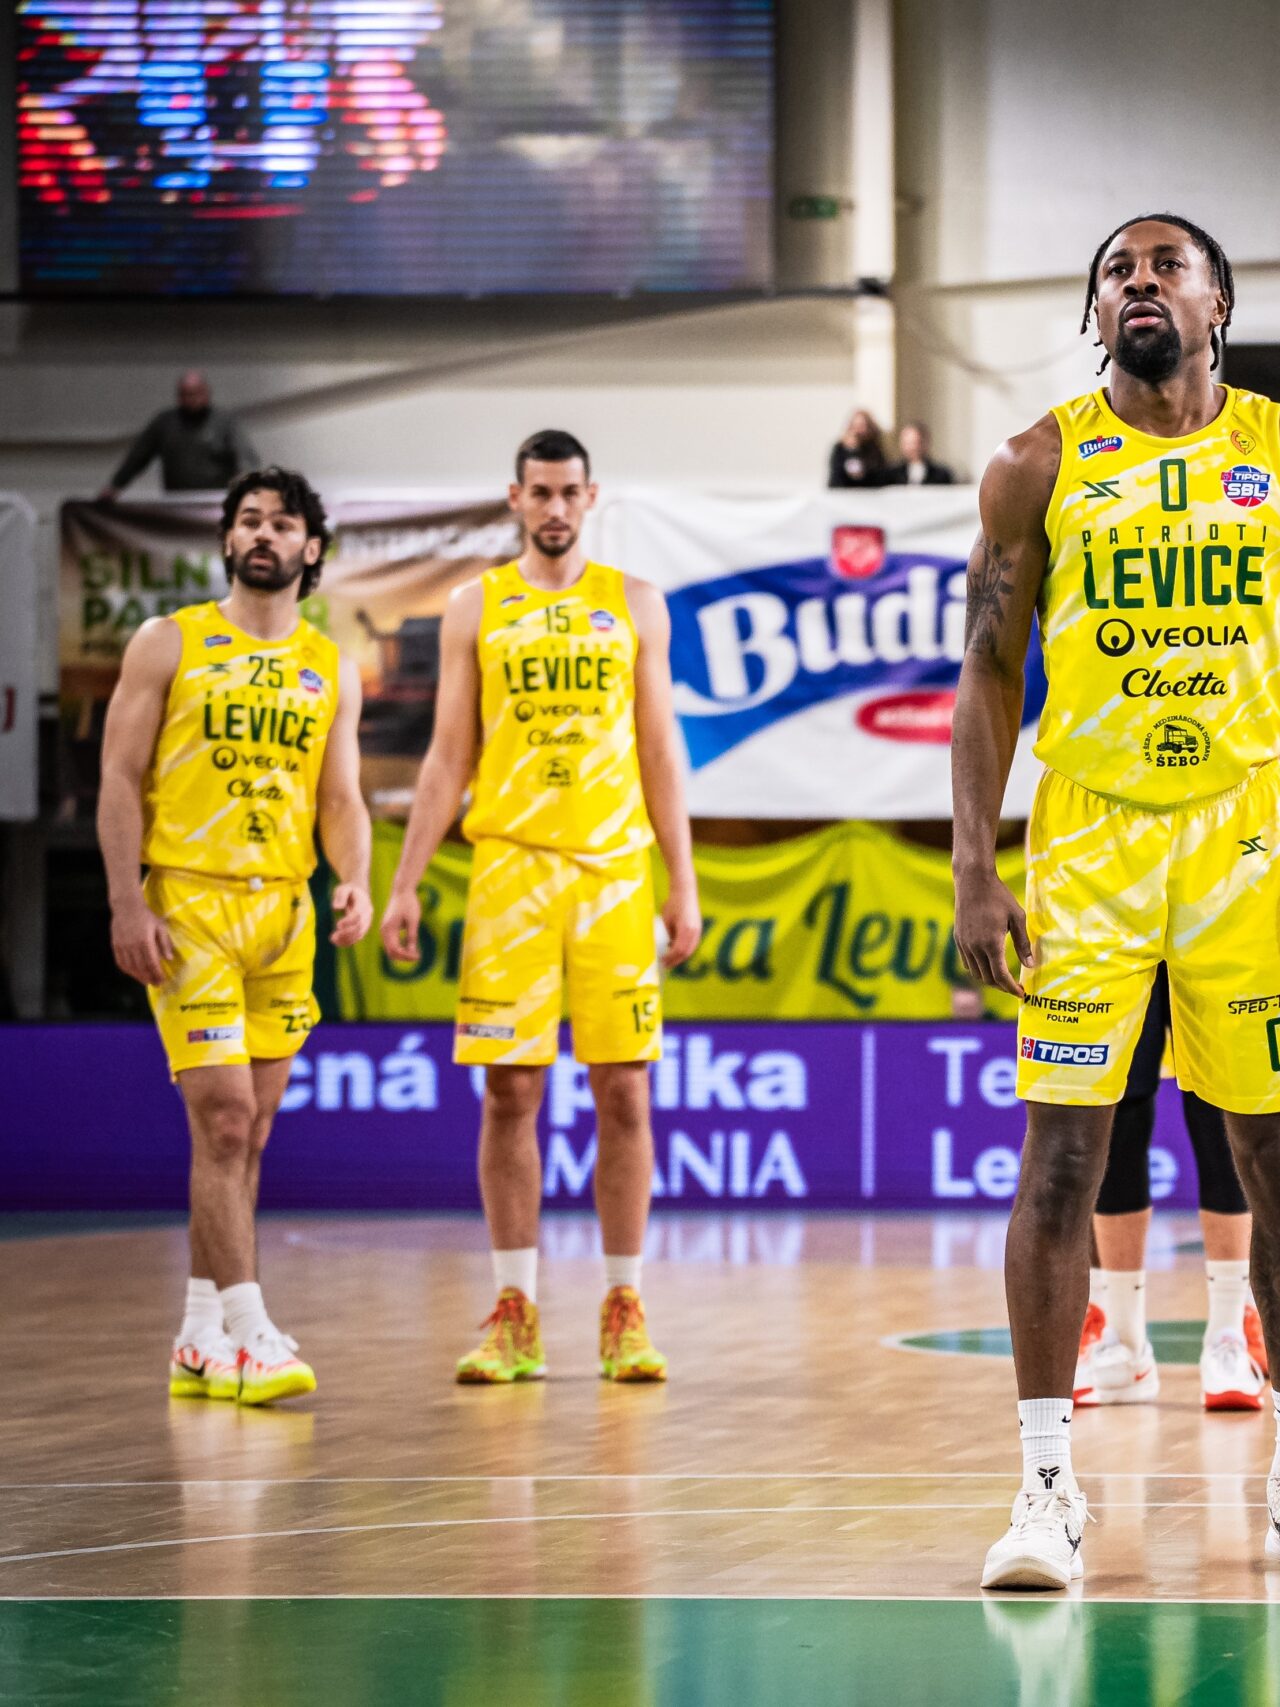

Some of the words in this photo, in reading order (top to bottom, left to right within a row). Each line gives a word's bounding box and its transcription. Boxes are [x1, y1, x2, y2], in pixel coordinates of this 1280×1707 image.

[1160, 458, 1188, 512] 0
[1235, 472, 1268, 482] TIPOS
[1227, 483, 1266, 498] SBL
[1082, 524, 1267, 547] PATRIOTI
[1083, 545, 1266, 610] LEVICE
[546, 605, 570, 633] 15
[680, 565, 967, 712] Budi
[1141, 625, 1248, 648] VEOLIA
[249, 656, 284, 689] 25
[504, 656, 612, 694] LEVICE
[1121, 667, 1228, 698] Cloetta
[203, 703, 317, 753] LEVICE
[1156, 754, 1200, 767] ŠEBO
[1030, 993, 1113, 1014] INTERSPORT
[1047, 1013, 1079, 1024] FOLTAN
[1037, 1043, 1105, 1064] TIPOS
